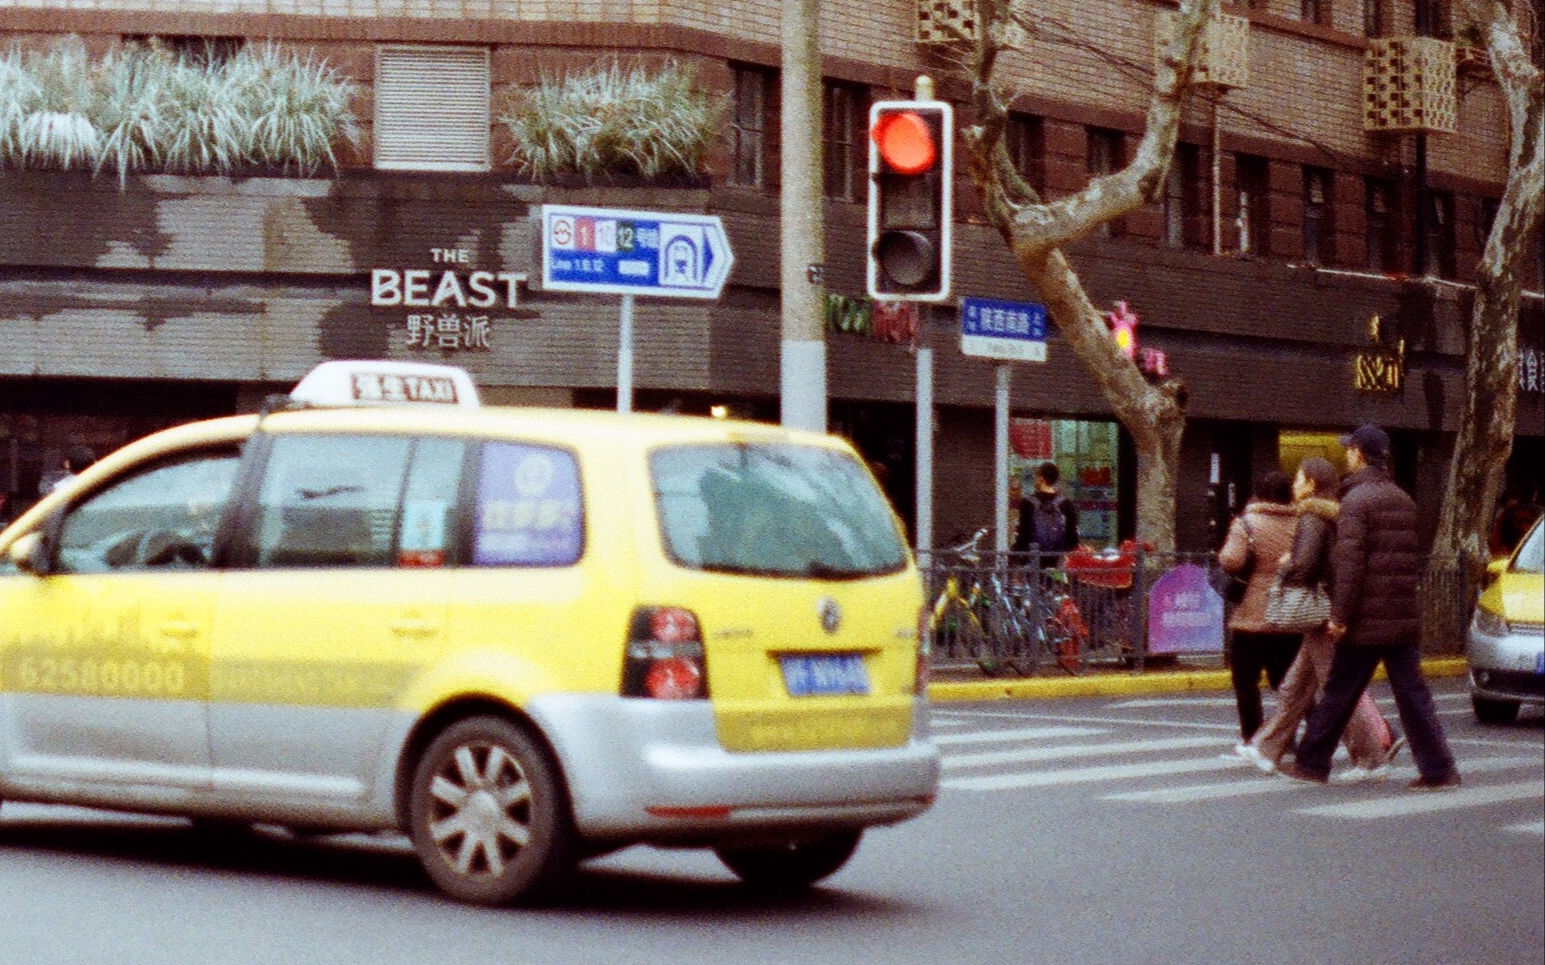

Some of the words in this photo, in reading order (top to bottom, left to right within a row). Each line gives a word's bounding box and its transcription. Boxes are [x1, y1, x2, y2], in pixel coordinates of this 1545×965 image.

[619, 227, 634, 248] 12
[431, 248, 469, 263] THE
[371, 268, 528, 308] BEAST
[407, 314, 491, 348] 野兽派
[18, 657, 185, 694] 62580000
